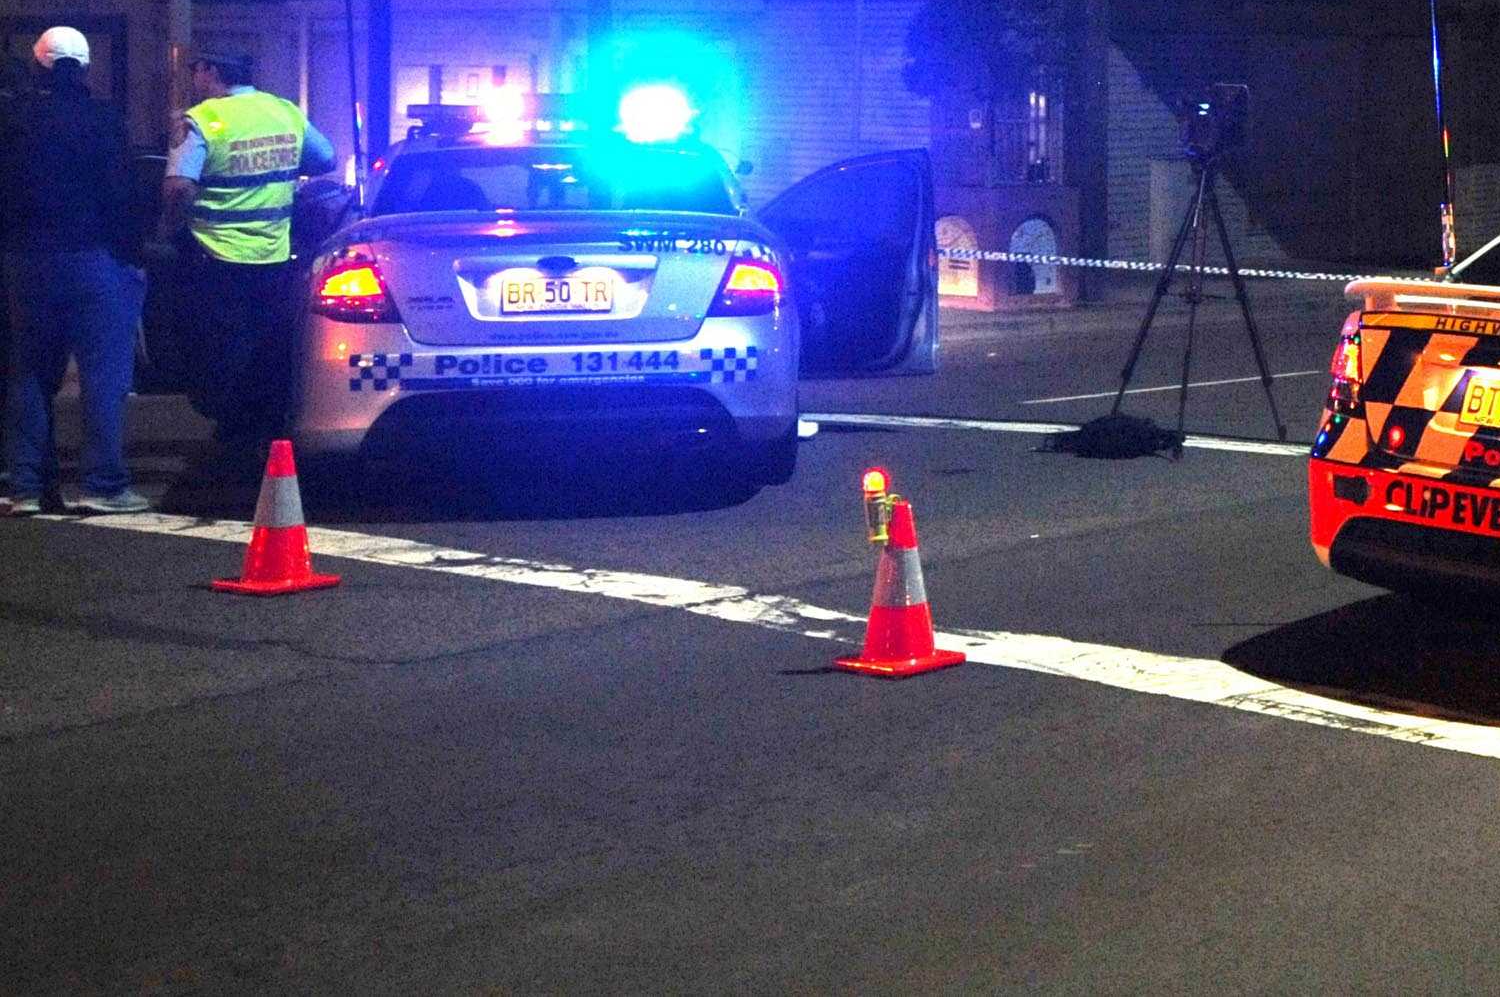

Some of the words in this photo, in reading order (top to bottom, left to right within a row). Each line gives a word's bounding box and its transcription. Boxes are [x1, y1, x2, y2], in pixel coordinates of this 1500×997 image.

[685, 238, 727, 256] 280
[507, 282, 536, 305] BR
[543, 280, 570, 304] 50
[581, 280, 609, 303] TR
[434, 354, 548, 377] Police
[570, 352, 618, 373] 131
[623, 350, 680, 371] 444
[1385, 480, 1451, 520] CLIP
